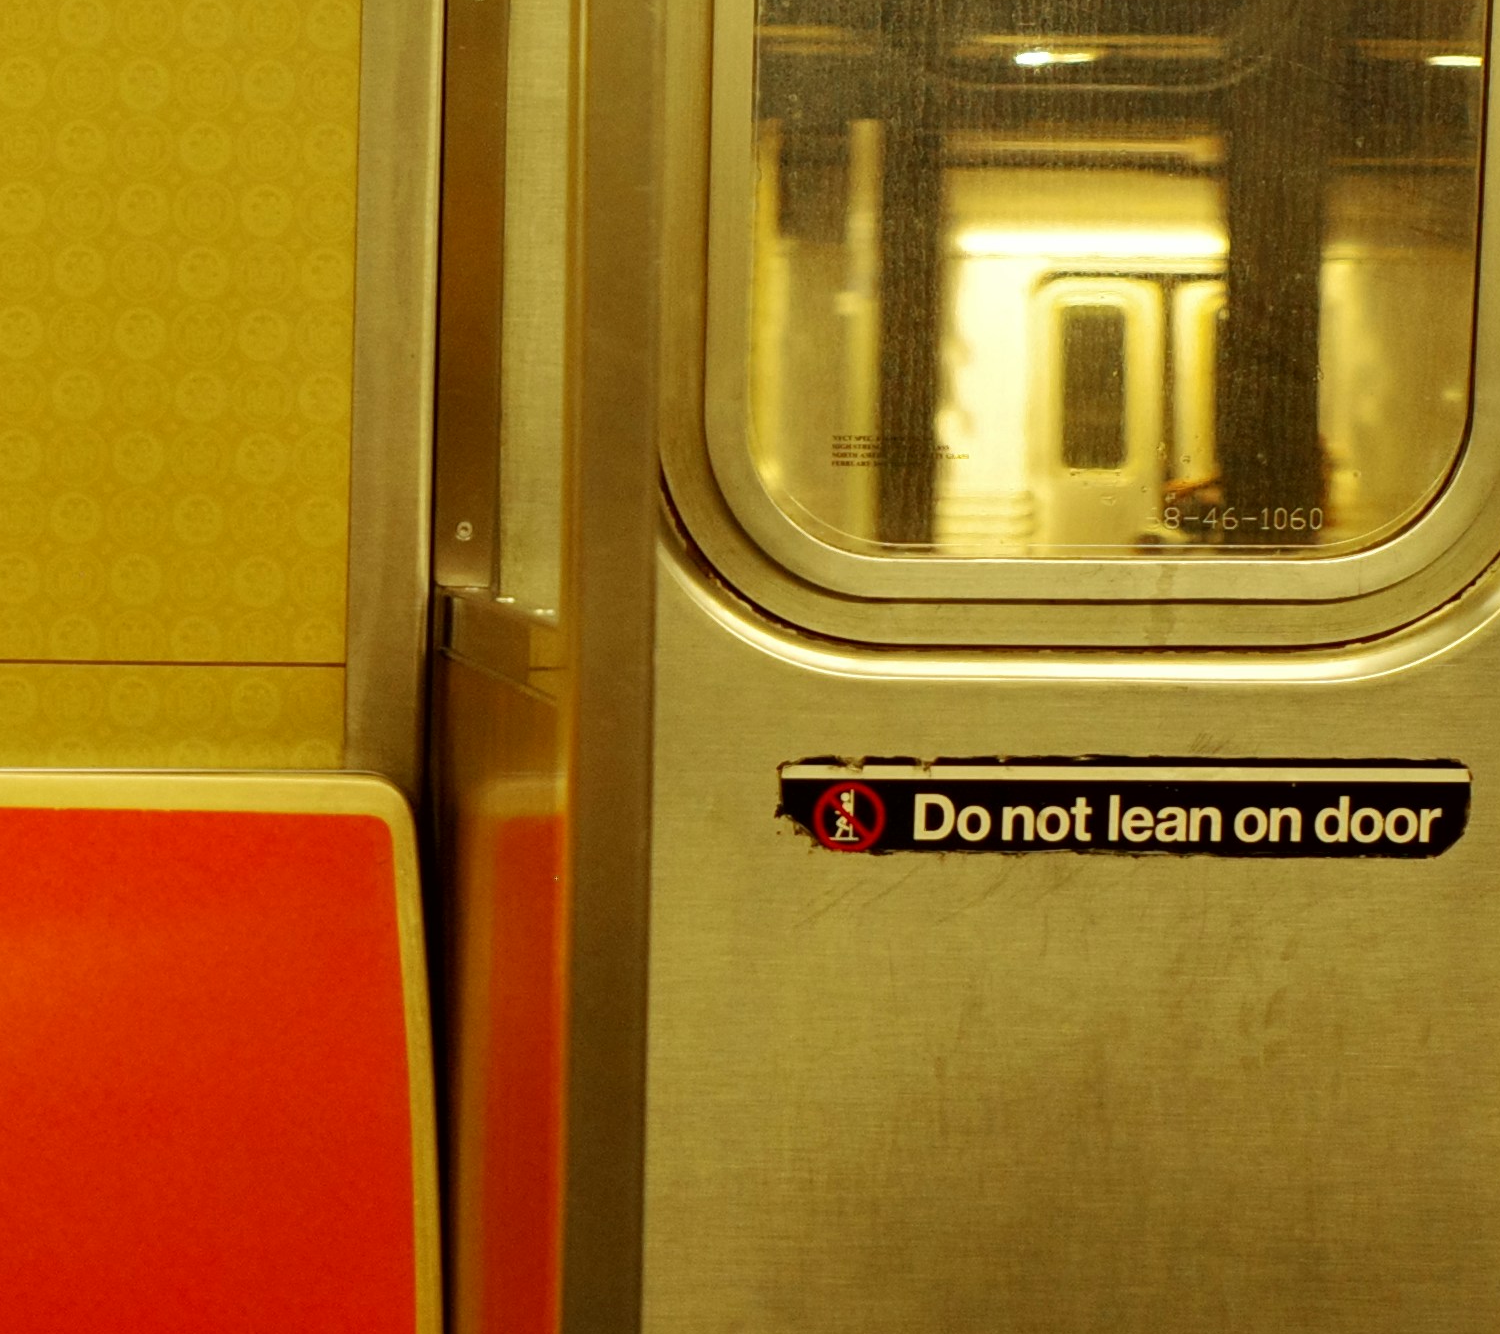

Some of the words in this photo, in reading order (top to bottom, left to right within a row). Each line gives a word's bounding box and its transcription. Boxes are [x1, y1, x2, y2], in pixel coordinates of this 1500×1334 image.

[913, 793, 992, 842] Do
[1001, 796, 1093, 842] not
[1108, 794, 1222, 843] lean
[1233, 806, 1302, 843] on
[1314, 795, 1442, 844] door
